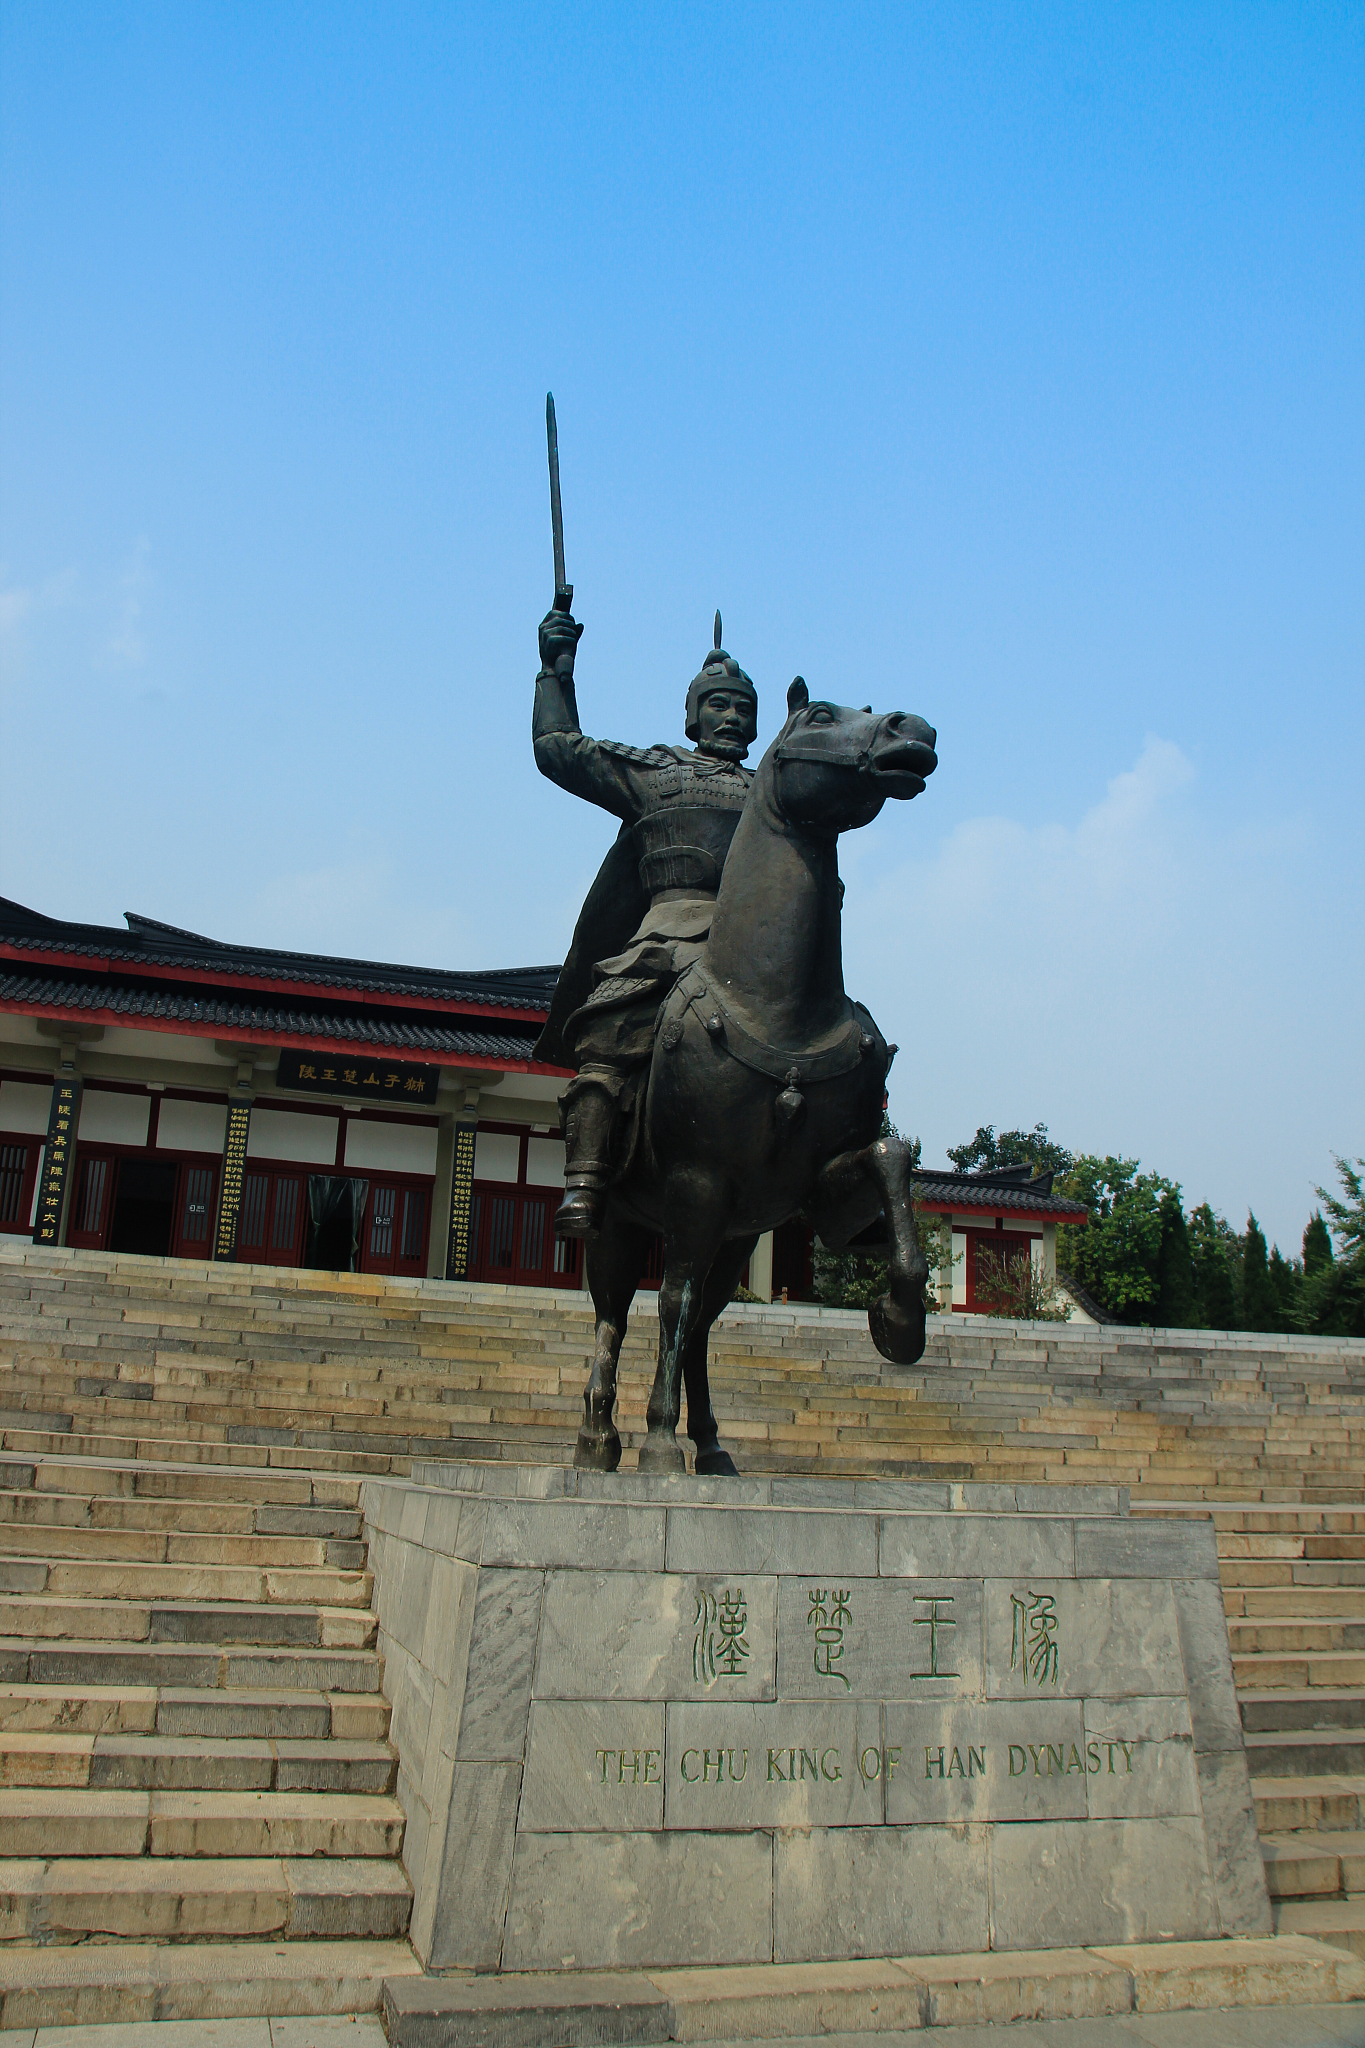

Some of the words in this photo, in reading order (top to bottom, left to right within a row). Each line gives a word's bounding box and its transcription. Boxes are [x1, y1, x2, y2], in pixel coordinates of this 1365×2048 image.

[693, 1588, 1059, 1693] 漢楚王像
[595, 1749, 661, 1784] THE
[681, 1748, 749, 1784] CHU
[766, 1748, 843, 1783] KING
[860, 1746, 903, 1781] OF
[924, 1745, 987, 1780] HAN
[1007, 1741, 1138, 1777] DYNASTY
